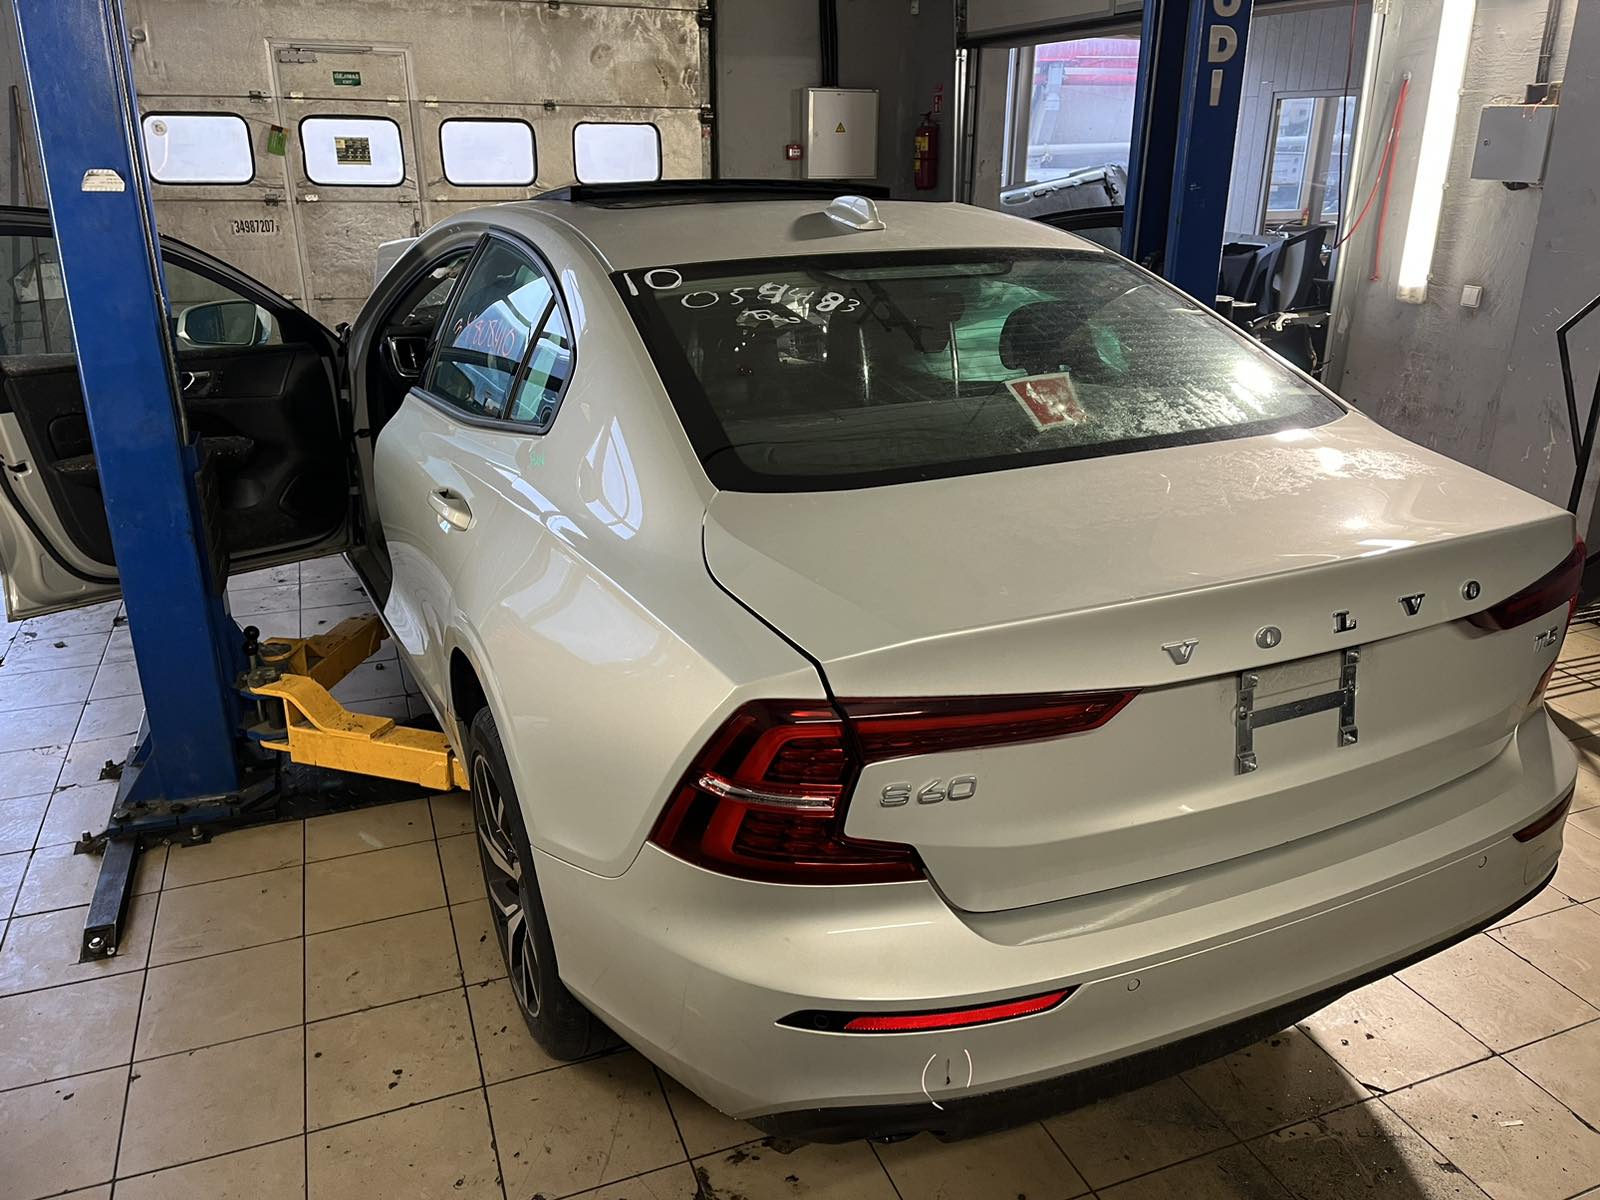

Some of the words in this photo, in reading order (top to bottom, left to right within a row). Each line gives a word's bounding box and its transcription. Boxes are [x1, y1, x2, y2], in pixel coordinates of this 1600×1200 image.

[233, 219, 275, 233] 34987207
[1161, 580, 1482, 666] VOLVO
[880, 775, 978, 808] S60
